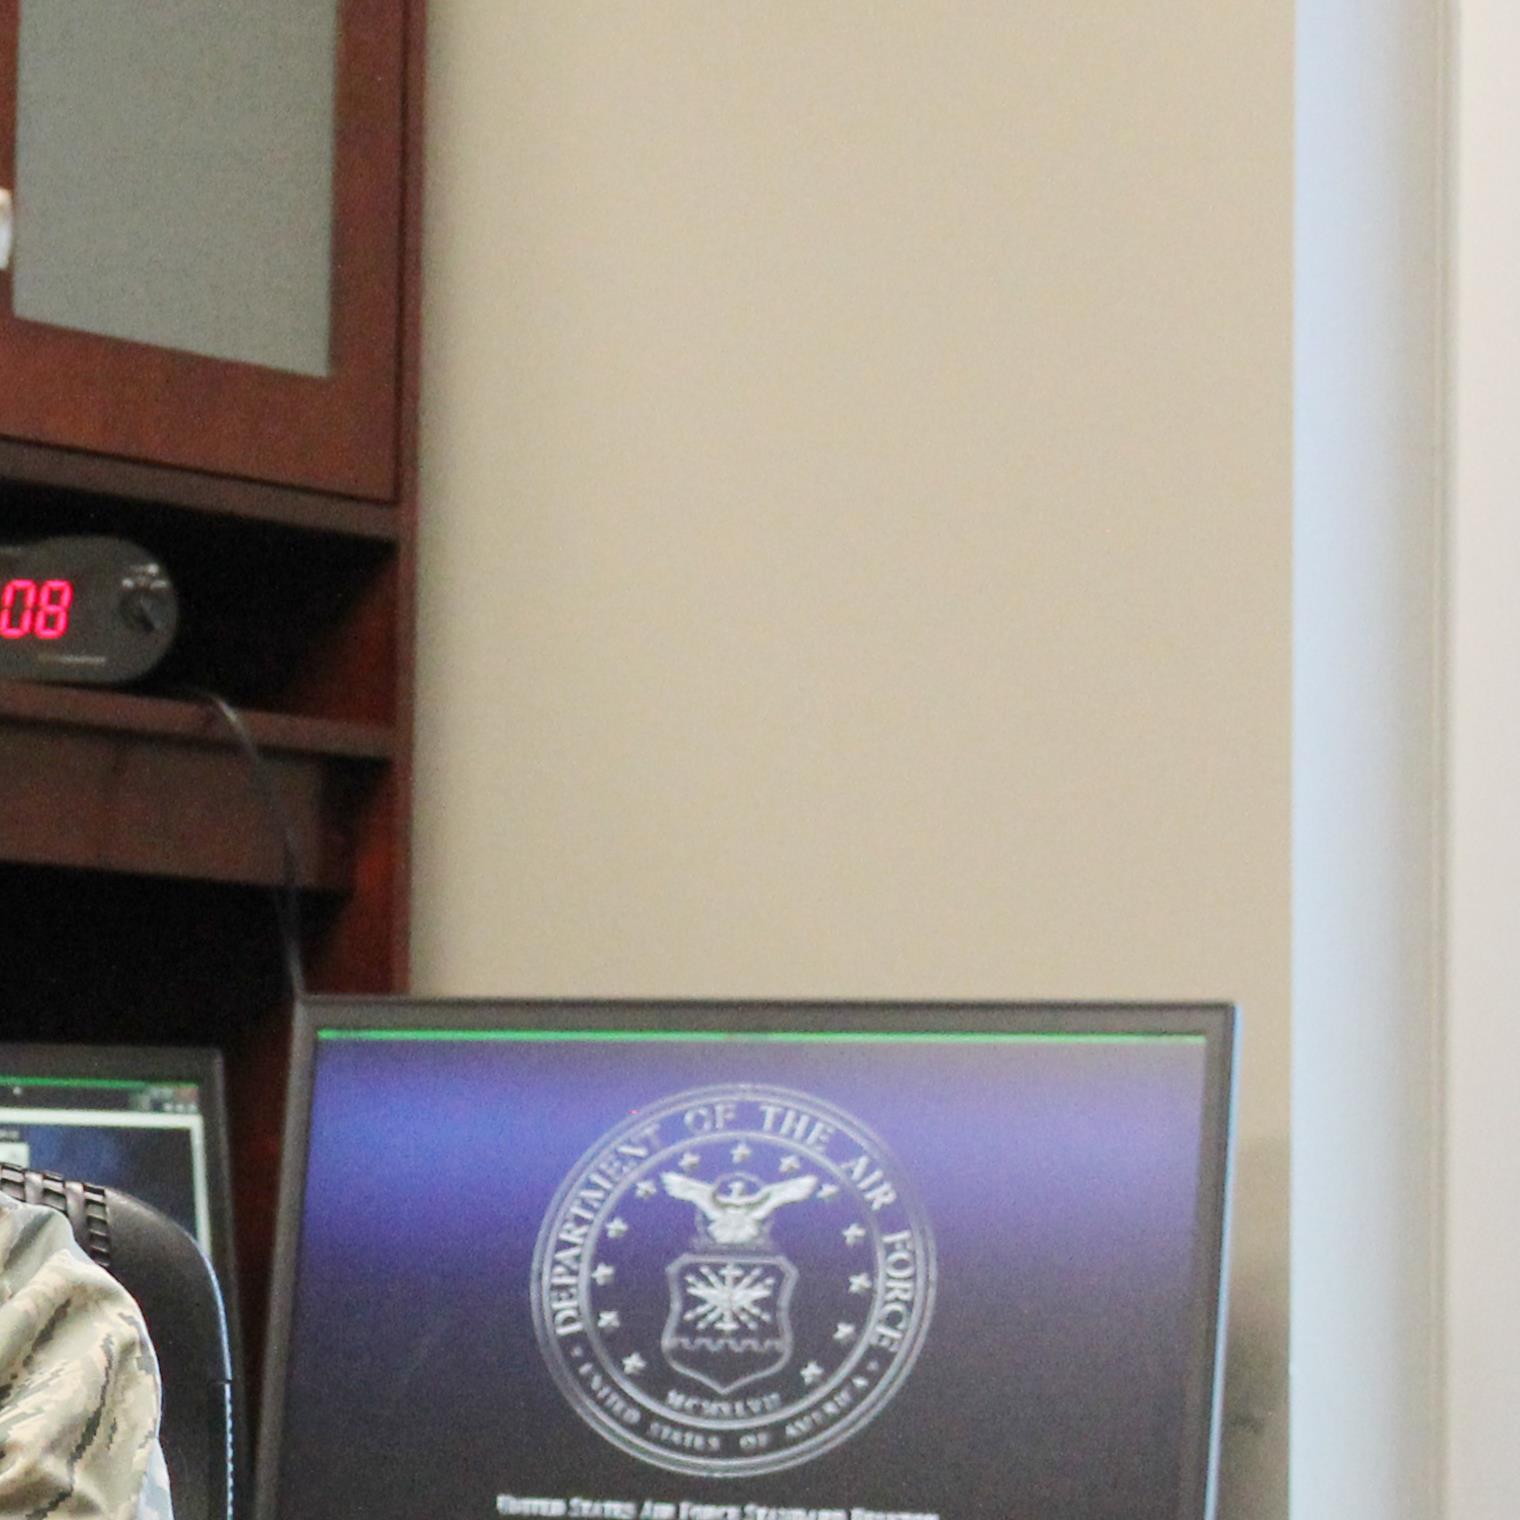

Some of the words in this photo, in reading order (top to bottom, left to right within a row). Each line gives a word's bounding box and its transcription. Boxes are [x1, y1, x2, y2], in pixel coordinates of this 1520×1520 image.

[551, 1127, 661, 1337] DEPARTMENT
[683, 1103, 738, 1132] OF
[760, 1105, 837, 1155] THE
[841, 1155, 898, 1211] AIR
[870, 1229, 916, 1353] FORCE
[649, 1421, 721, 1450] STATES
[739, 1432, 770, 1450] OF
